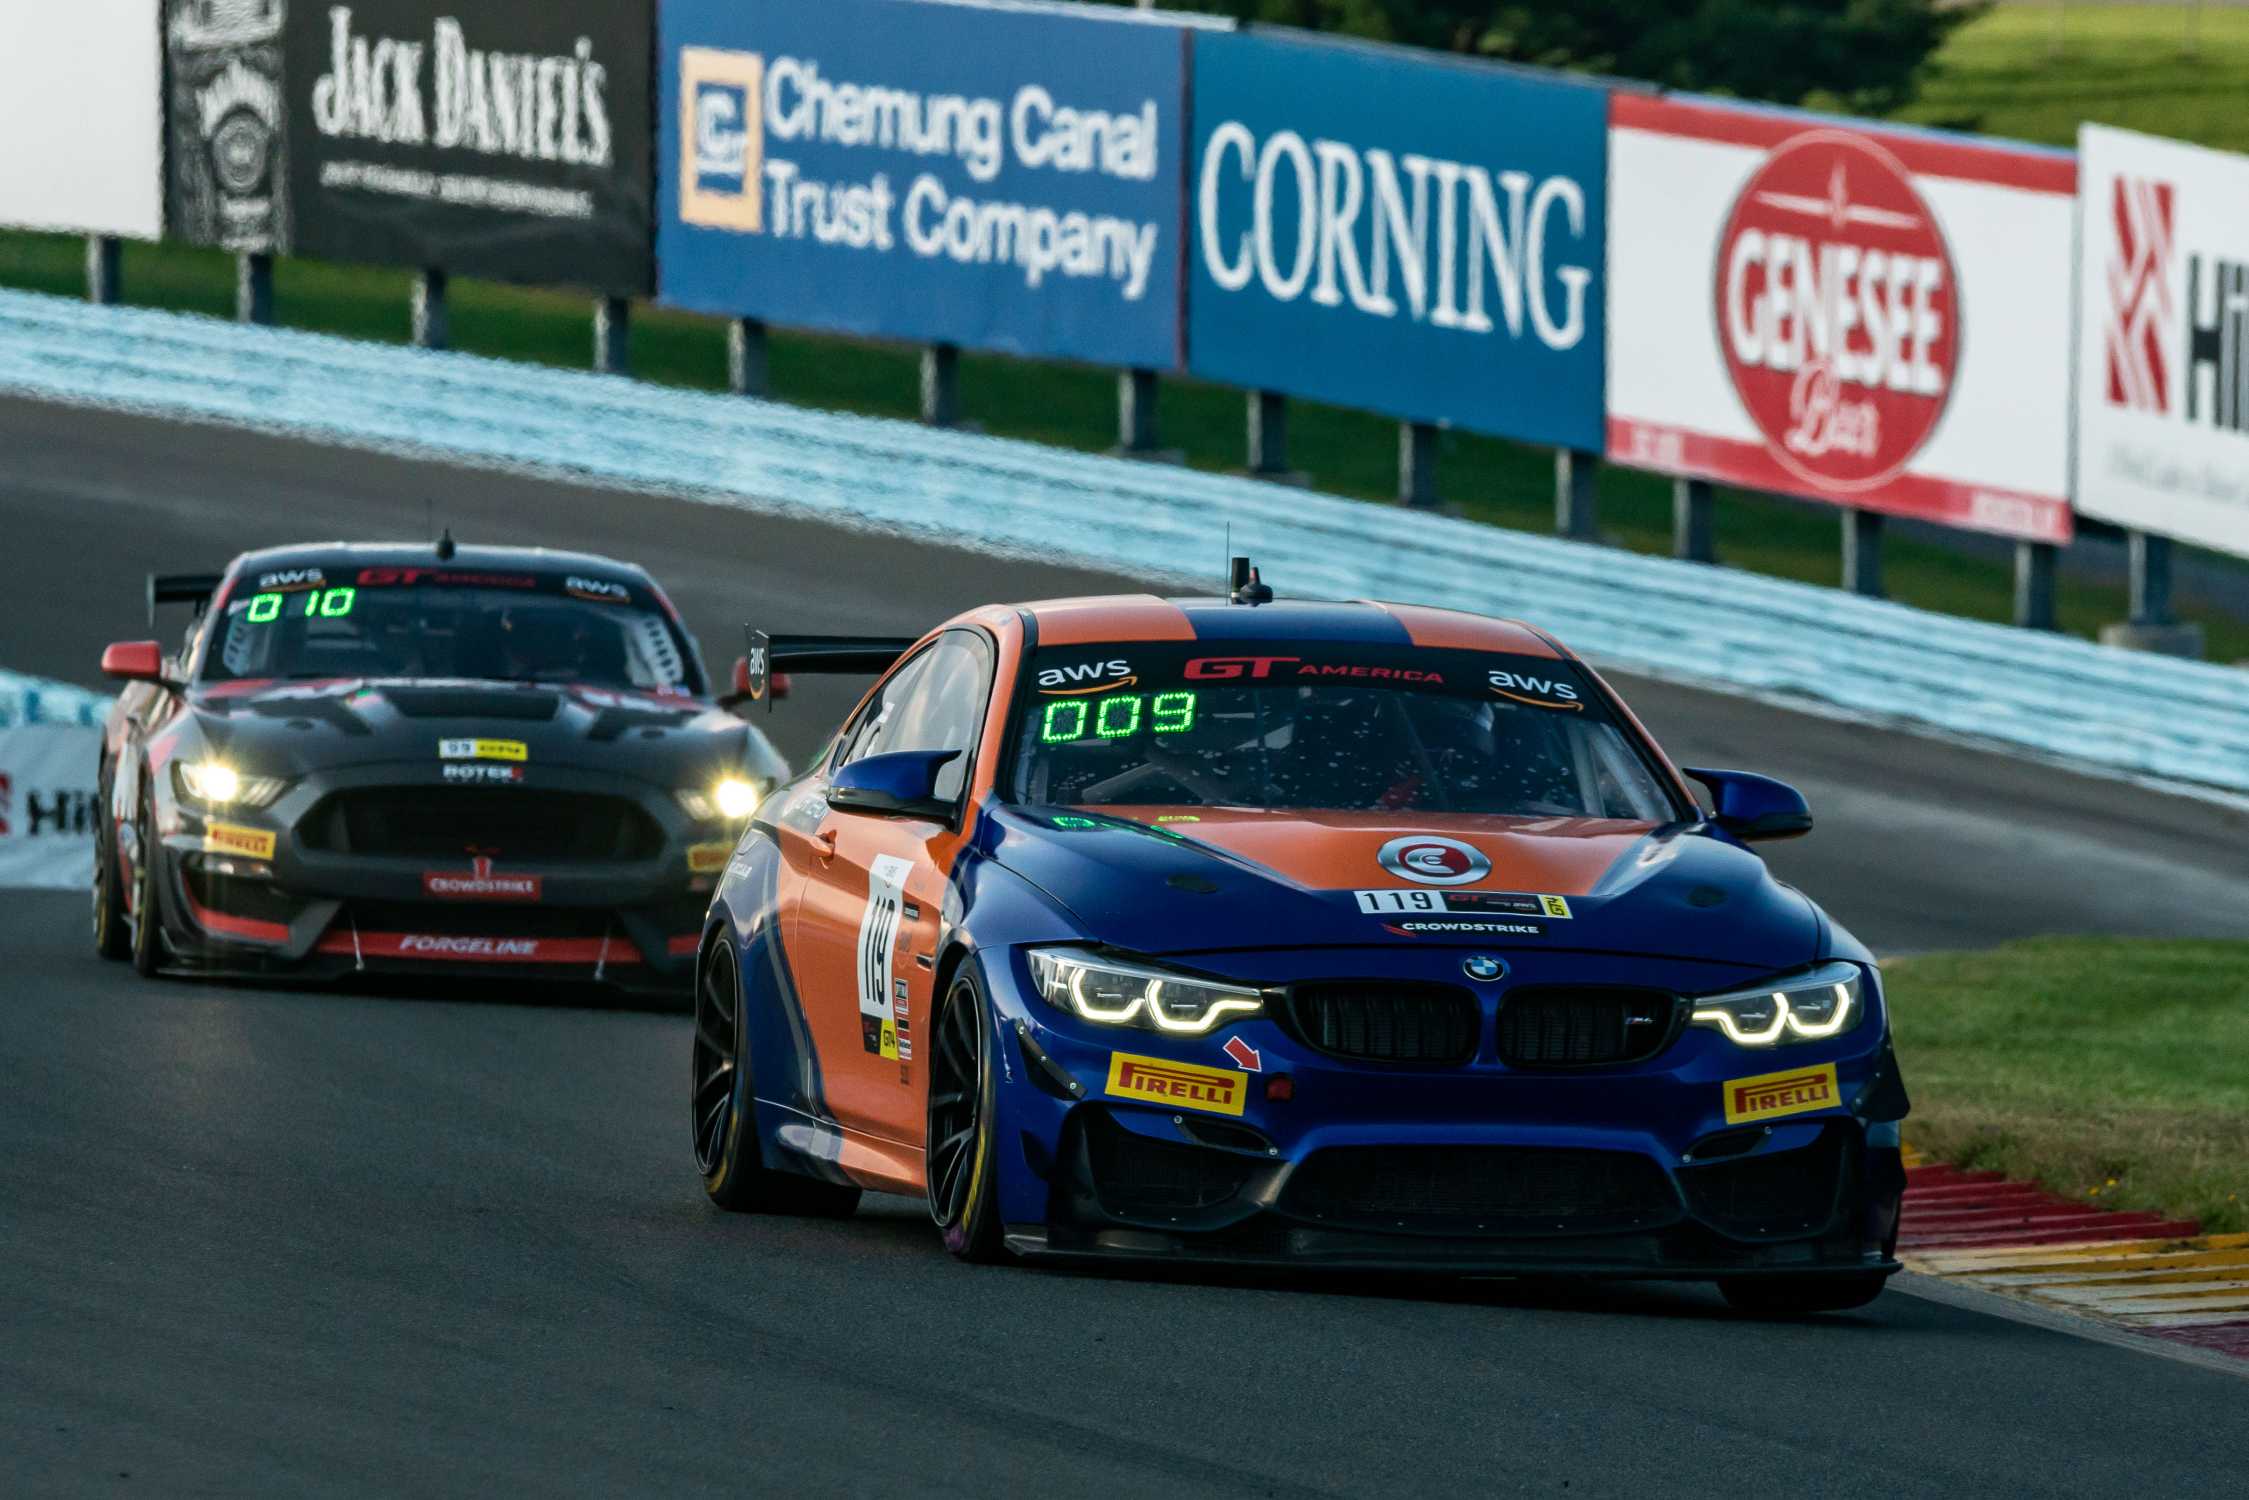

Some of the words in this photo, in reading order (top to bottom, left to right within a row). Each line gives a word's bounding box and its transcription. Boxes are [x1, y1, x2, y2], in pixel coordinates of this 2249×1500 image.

[766, 57, 1002, 182] Chemung
[1012, 85, 1158, 181] Canal
[764, 158, 894, 251] Trust
[903, 173, 1158, 300] Company
[1200, 121, 1591, 351] CORNING
[1727, 228, 1942, 396] GENESEE
[259, 568, 323, 588] aws
[565, 576, 629, 598] aws
[750, 648, 765, 675] aws
[1038, 659, 1131, 687] aws
[1183, 657, 1300, 679] GT
[1298, 665, 1444, 684] AMERICA
[1488, 670, 1578, 699] aws
[1042, 691, 1197, 744] 009
[429, 877, 534, 893] CROWDSTRIKE
[1363, 891, 1434, 911] 119
[1402, 922, 1540, 935] CROWDSTRIKE
[399, 934, 539, 956] FORGELINE
[864, 894, 896, 1006] 119
[1119, 1061, 1235, 1105] PIRELLI
[1734, 1072, 1830, 1114] PIRELLI
